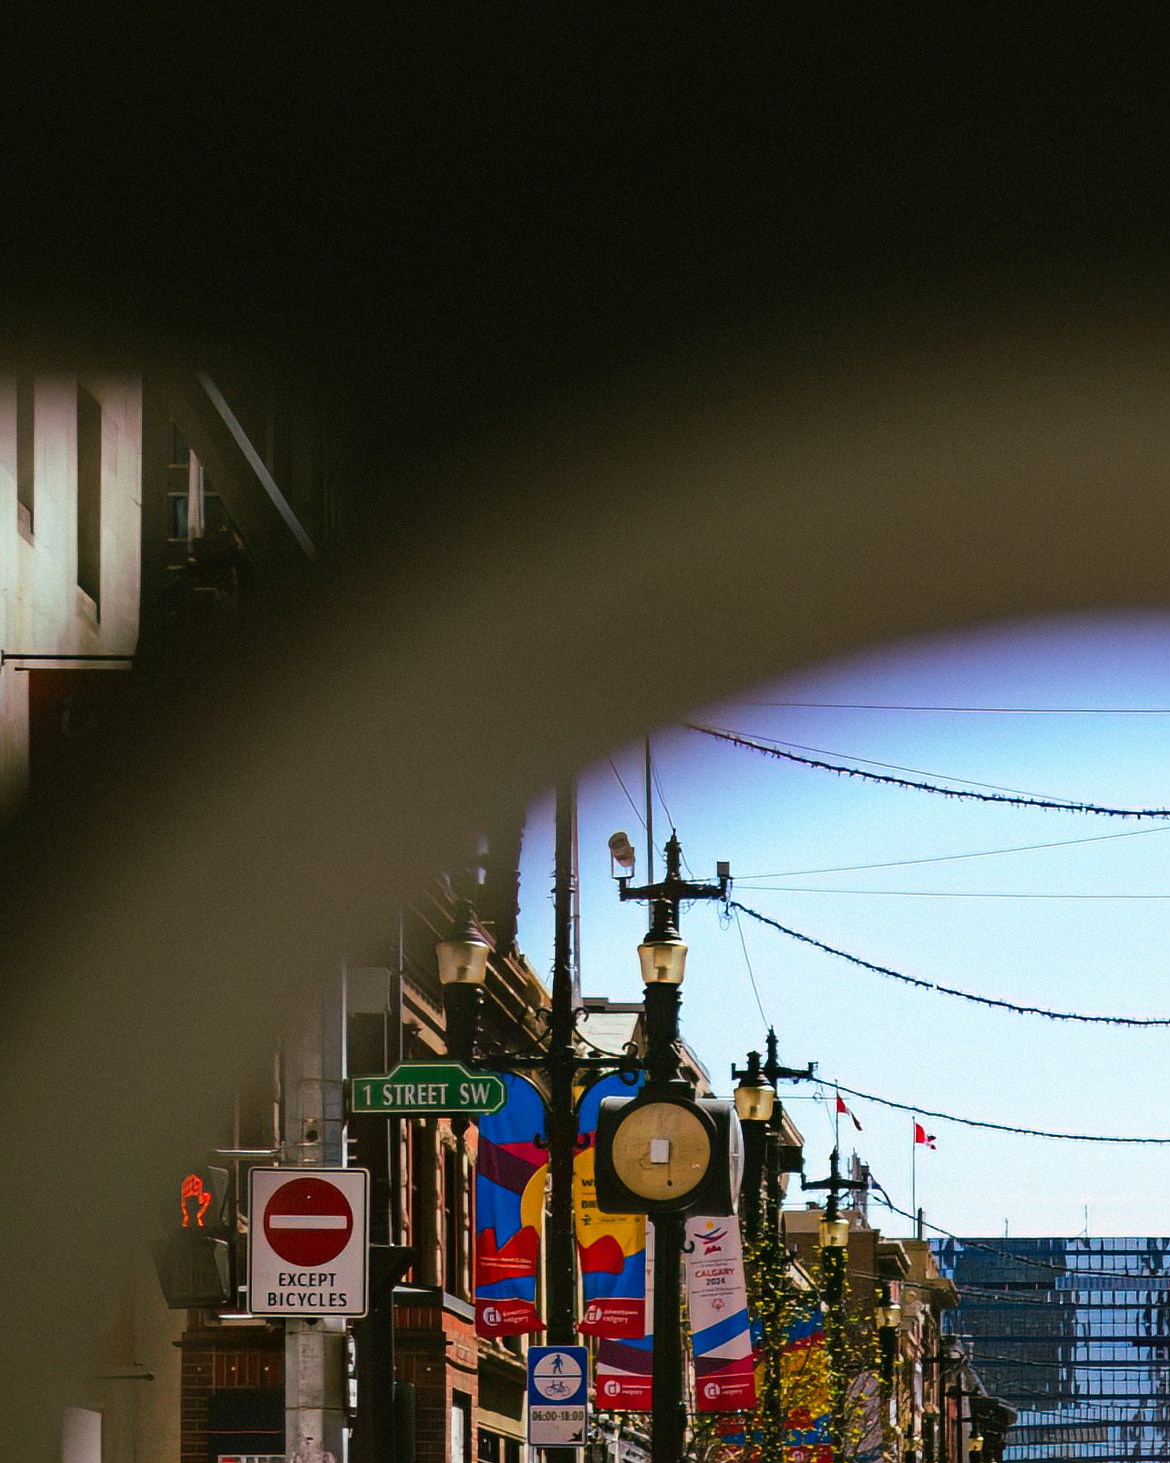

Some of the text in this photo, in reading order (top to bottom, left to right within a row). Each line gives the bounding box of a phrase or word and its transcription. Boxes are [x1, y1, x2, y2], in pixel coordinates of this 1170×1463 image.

[362, 1082, 492, 1106] 1 STREET SW
[278, 1272, 337, 1288] EXCEPT
[695, 1267, 735, 1279] CALGARY
[706, 1277, 726, 1287] 2024
[267, 1291, 348, 1307] BICYCLES
